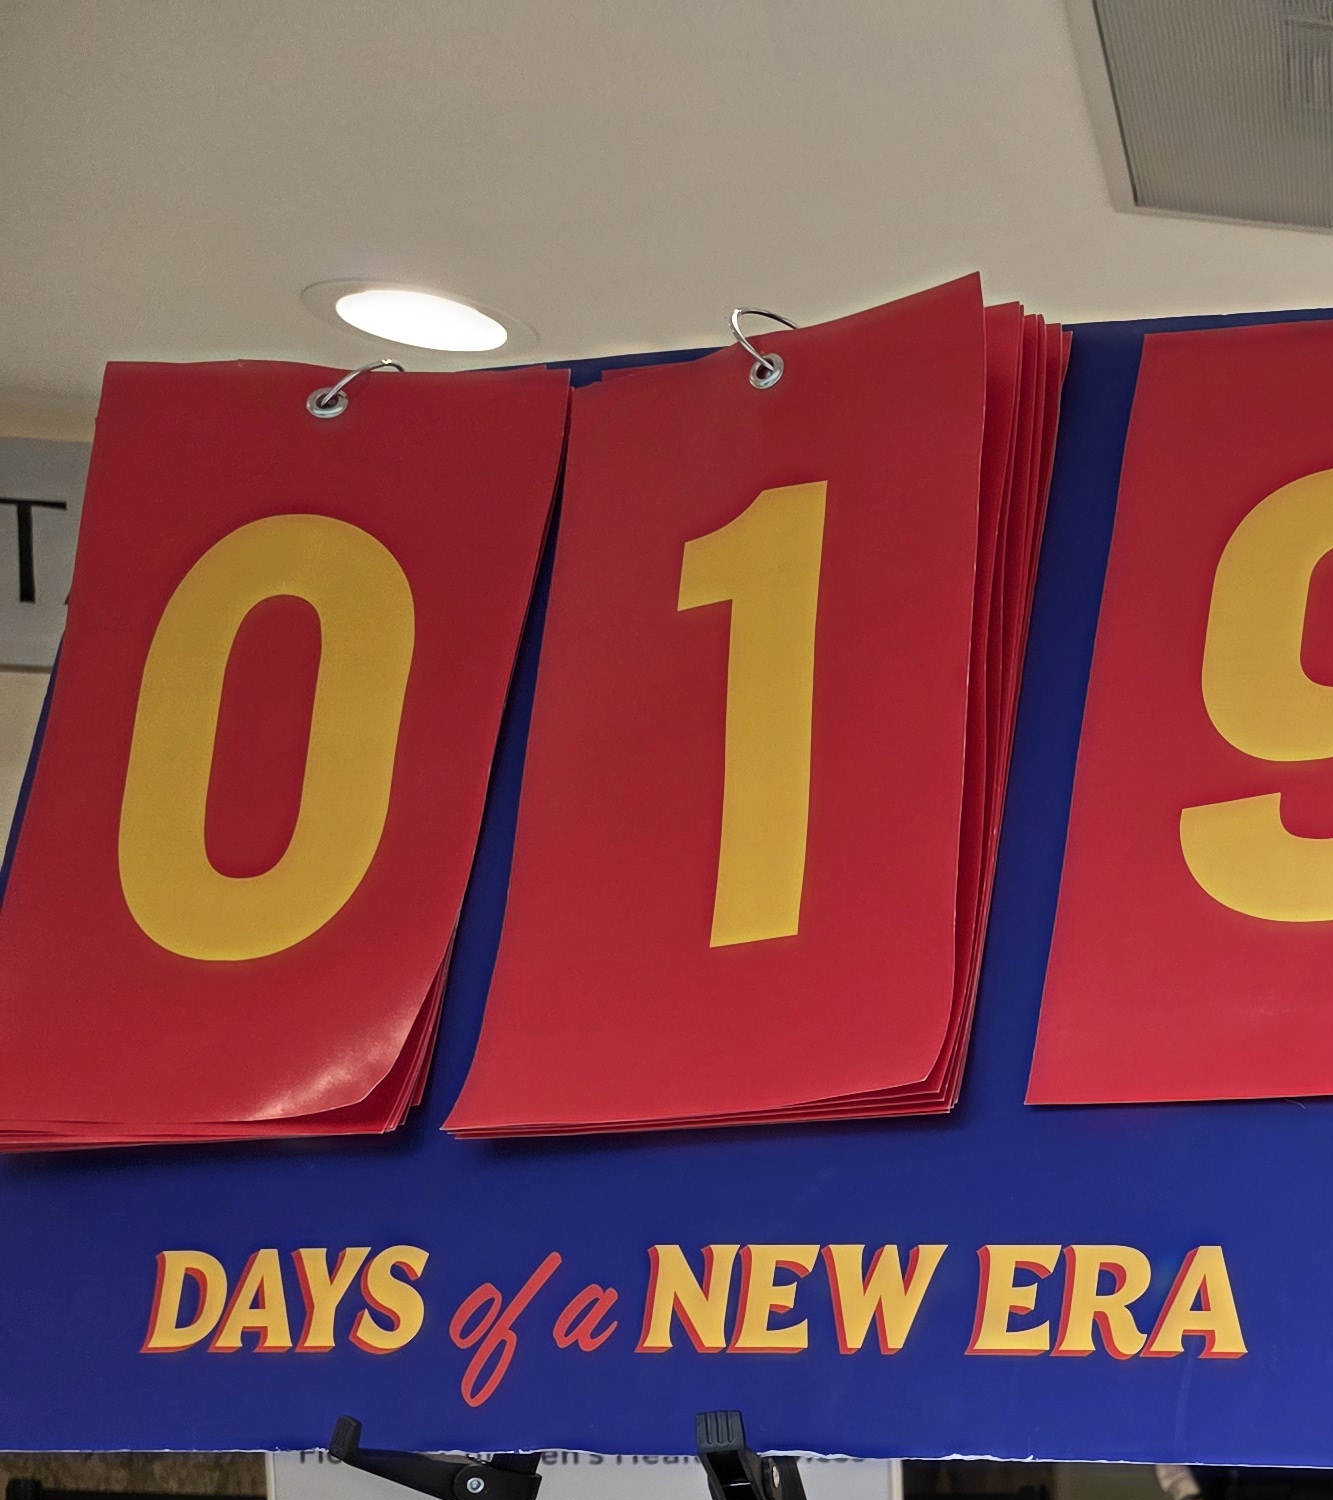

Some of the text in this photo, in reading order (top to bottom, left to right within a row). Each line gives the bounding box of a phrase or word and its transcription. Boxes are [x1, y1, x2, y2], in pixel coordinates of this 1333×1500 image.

[141, 1245, 1247, 1407] DAYS of a NEW ERA
